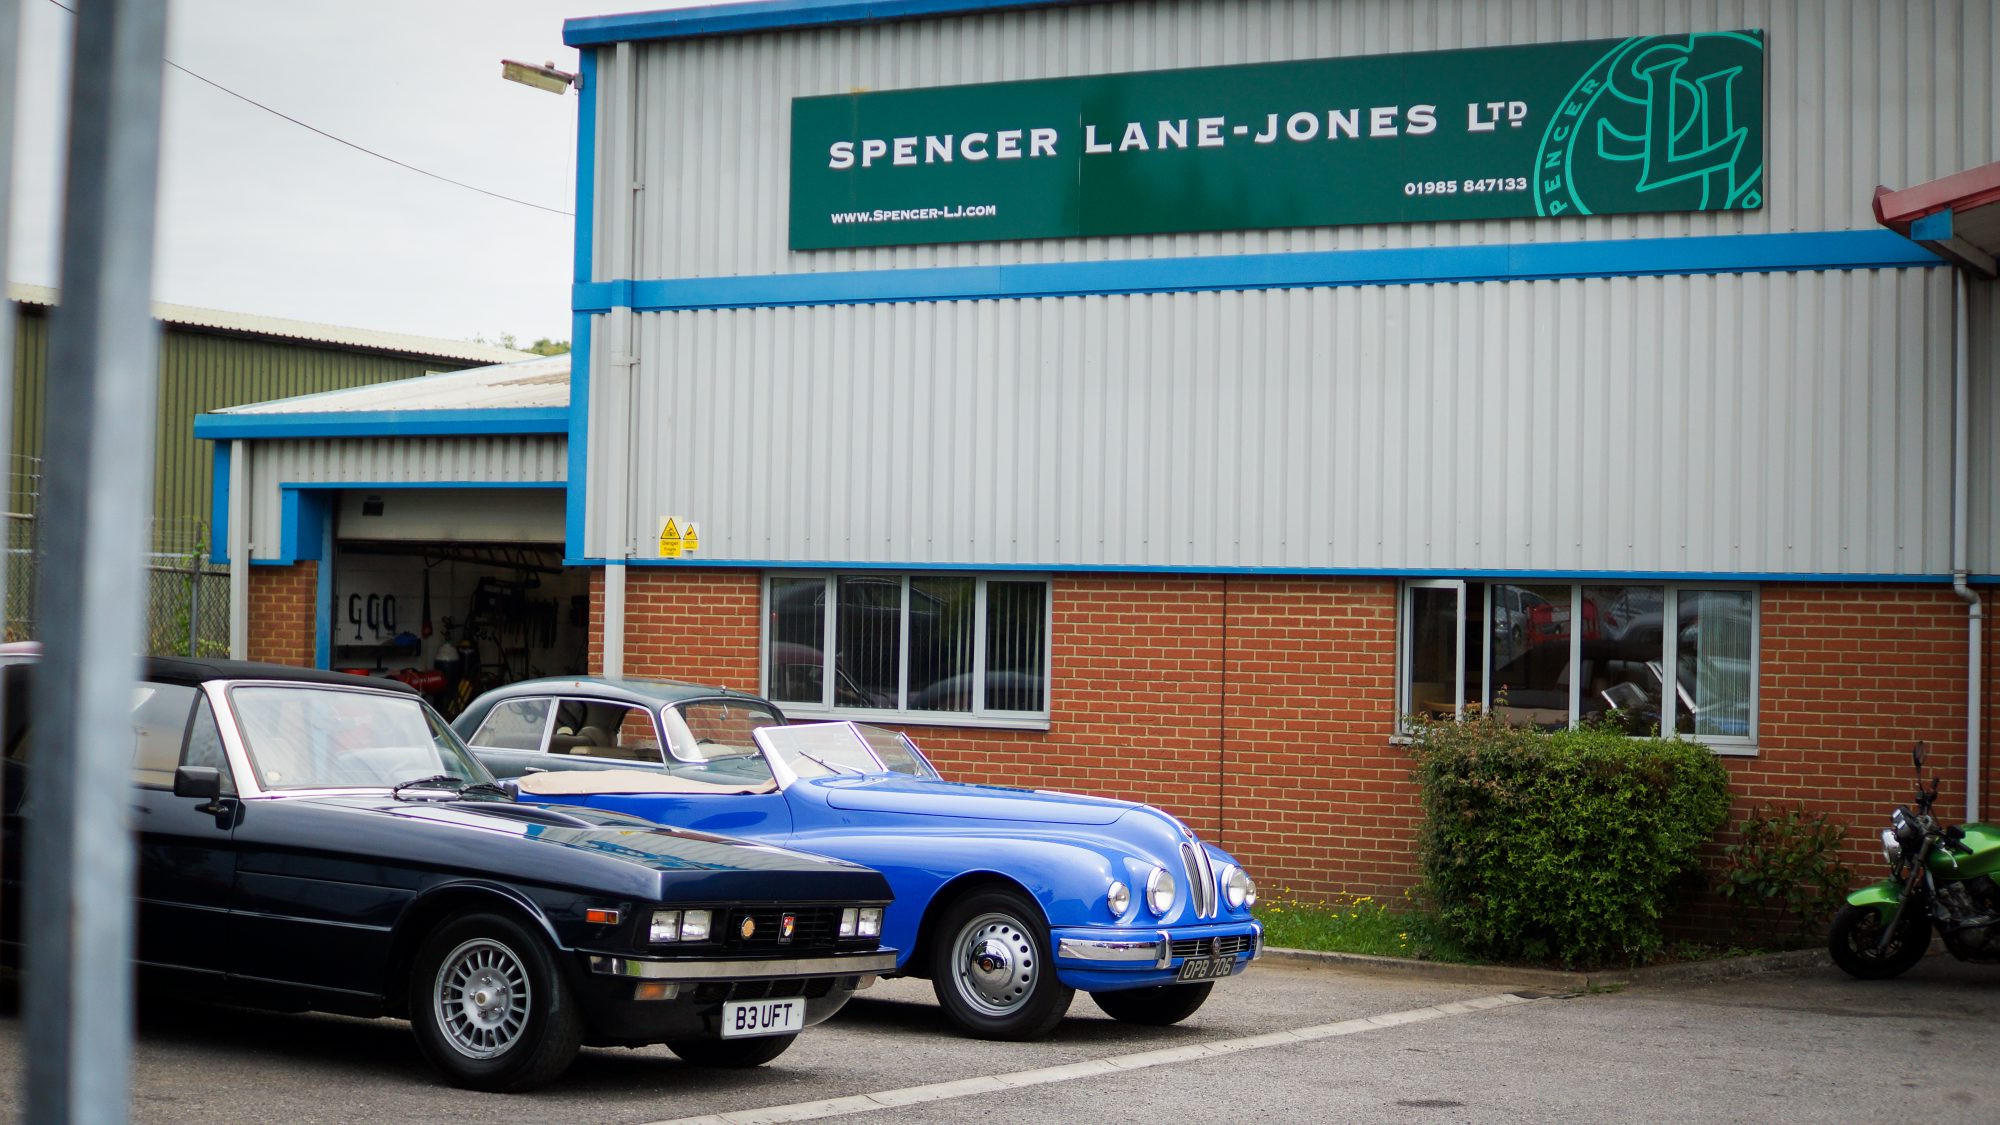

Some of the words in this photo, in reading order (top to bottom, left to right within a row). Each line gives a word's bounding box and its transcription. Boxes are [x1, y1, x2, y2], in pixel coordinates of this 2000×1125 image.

[829, 127, 1058, 168] SPENCER
[1085, 104, 1437, 153] LANE-JONES
[1404, 180, 1458, 195] 01985
[1463, 177, 1527, 193] 847133
[1183, 959, 1209, 979] OPB
[1209, 957, 1232, 976] 706
[735, 1006, 757, 1030] B3
[761, 1003, 793, 1028] UFT
